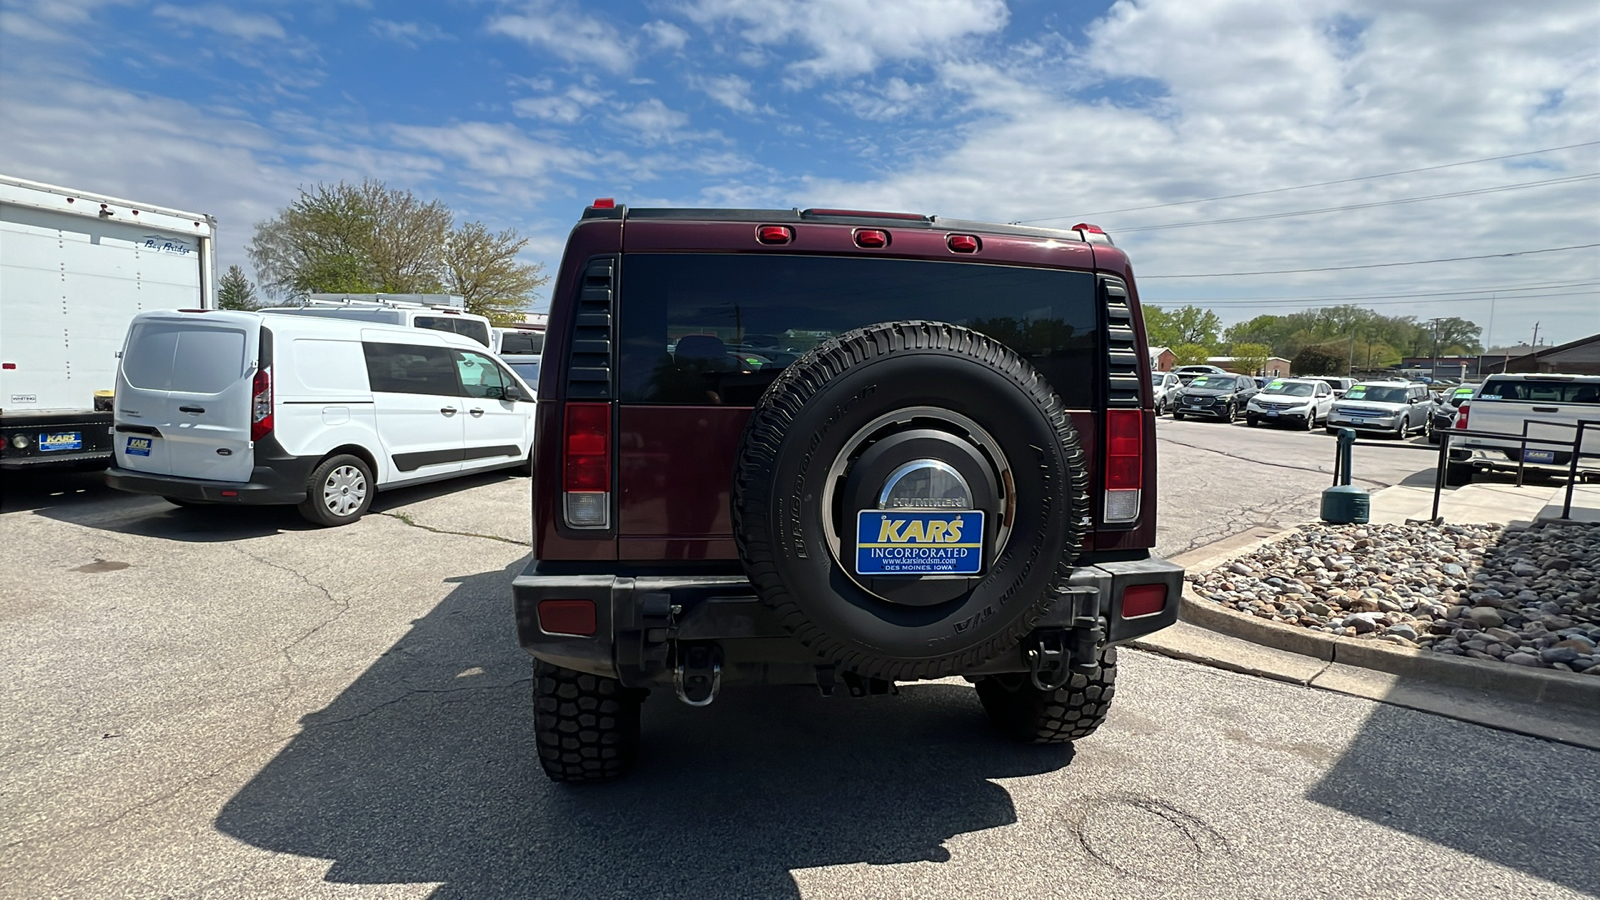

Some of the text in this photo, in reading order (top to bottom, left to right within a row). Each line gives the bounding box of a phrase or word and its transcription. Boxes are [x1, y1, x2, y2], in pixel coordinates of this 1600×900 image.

[163, 242, 190, 255] Bridge
[46, 434, 76, 444] KARS
[131, 439, 149, 448] KARS
[893, 497, 963, 507] HUMMER
[877, 519, 964, 543] KARS
[871, 547, 968, 558] INCORPORATED
